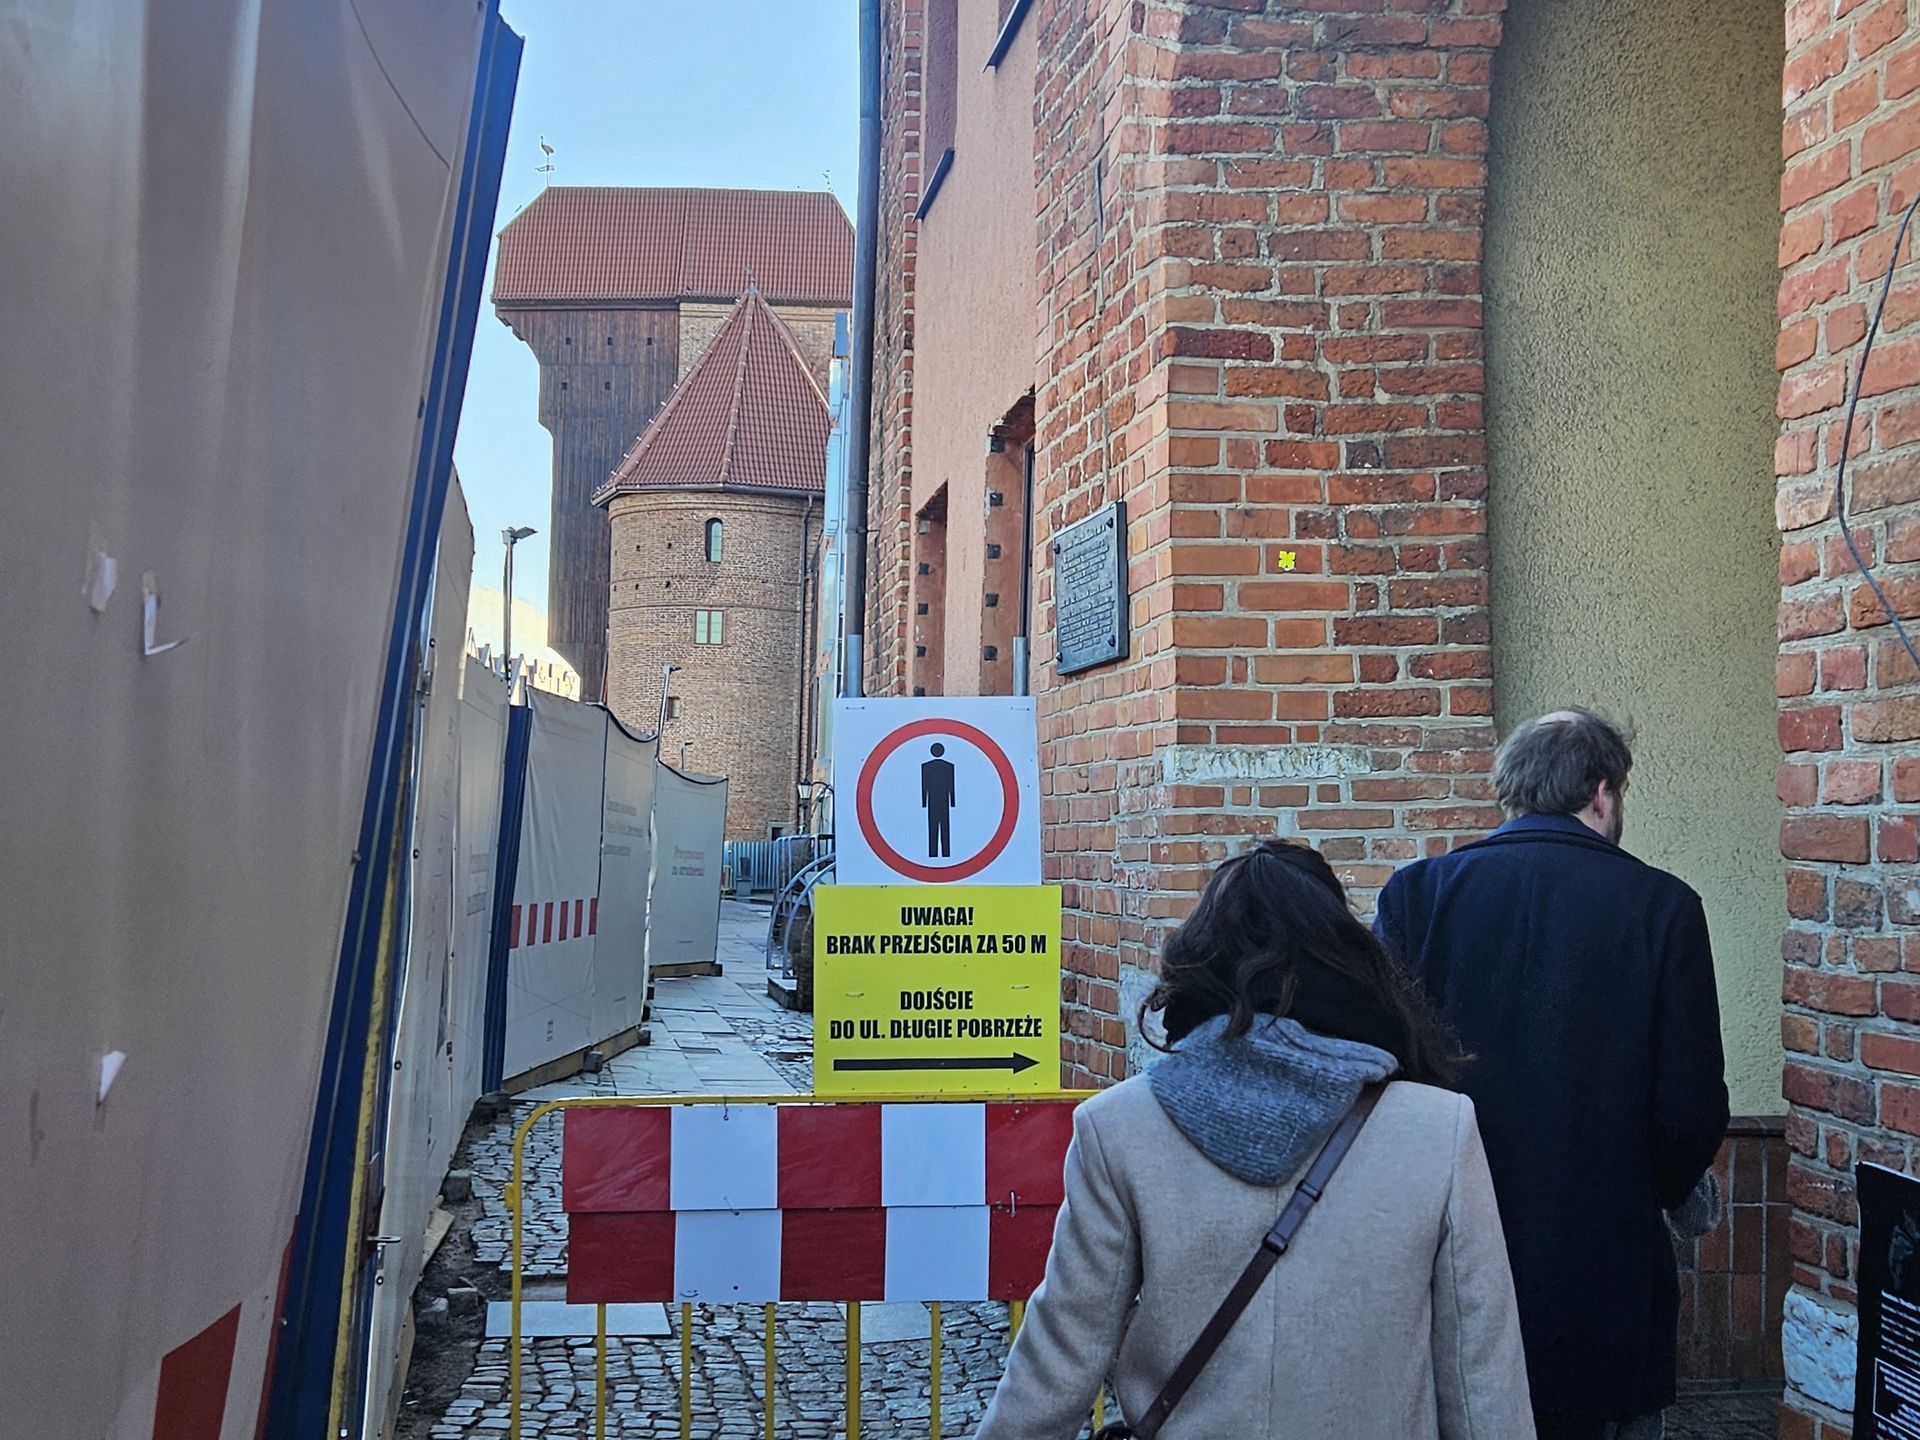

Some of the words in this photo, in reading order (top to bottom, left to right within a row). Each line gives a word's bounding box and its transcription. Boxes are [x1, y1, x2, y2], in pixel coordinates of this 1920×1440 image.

[901, 906, 974, 926] UWAGA!
[826, 935, 876, 954] BRAK
[880, 931, 973, 954] PRZEJŚCIA
[976, 934, 998, 954] ZA
[1002, 934, 1026, 954] 50
[1030, 934, 1047, 954] M
[900, 987, 973, 1010] DOJŚCIE
[830, 1020, 855, 1039] DO
[859, 1020, 886, 1039] UL.
[890, 1019, 953, 1038] DŁUGIE
[957, 1015, 1042, 1038] POBRZEŻE
